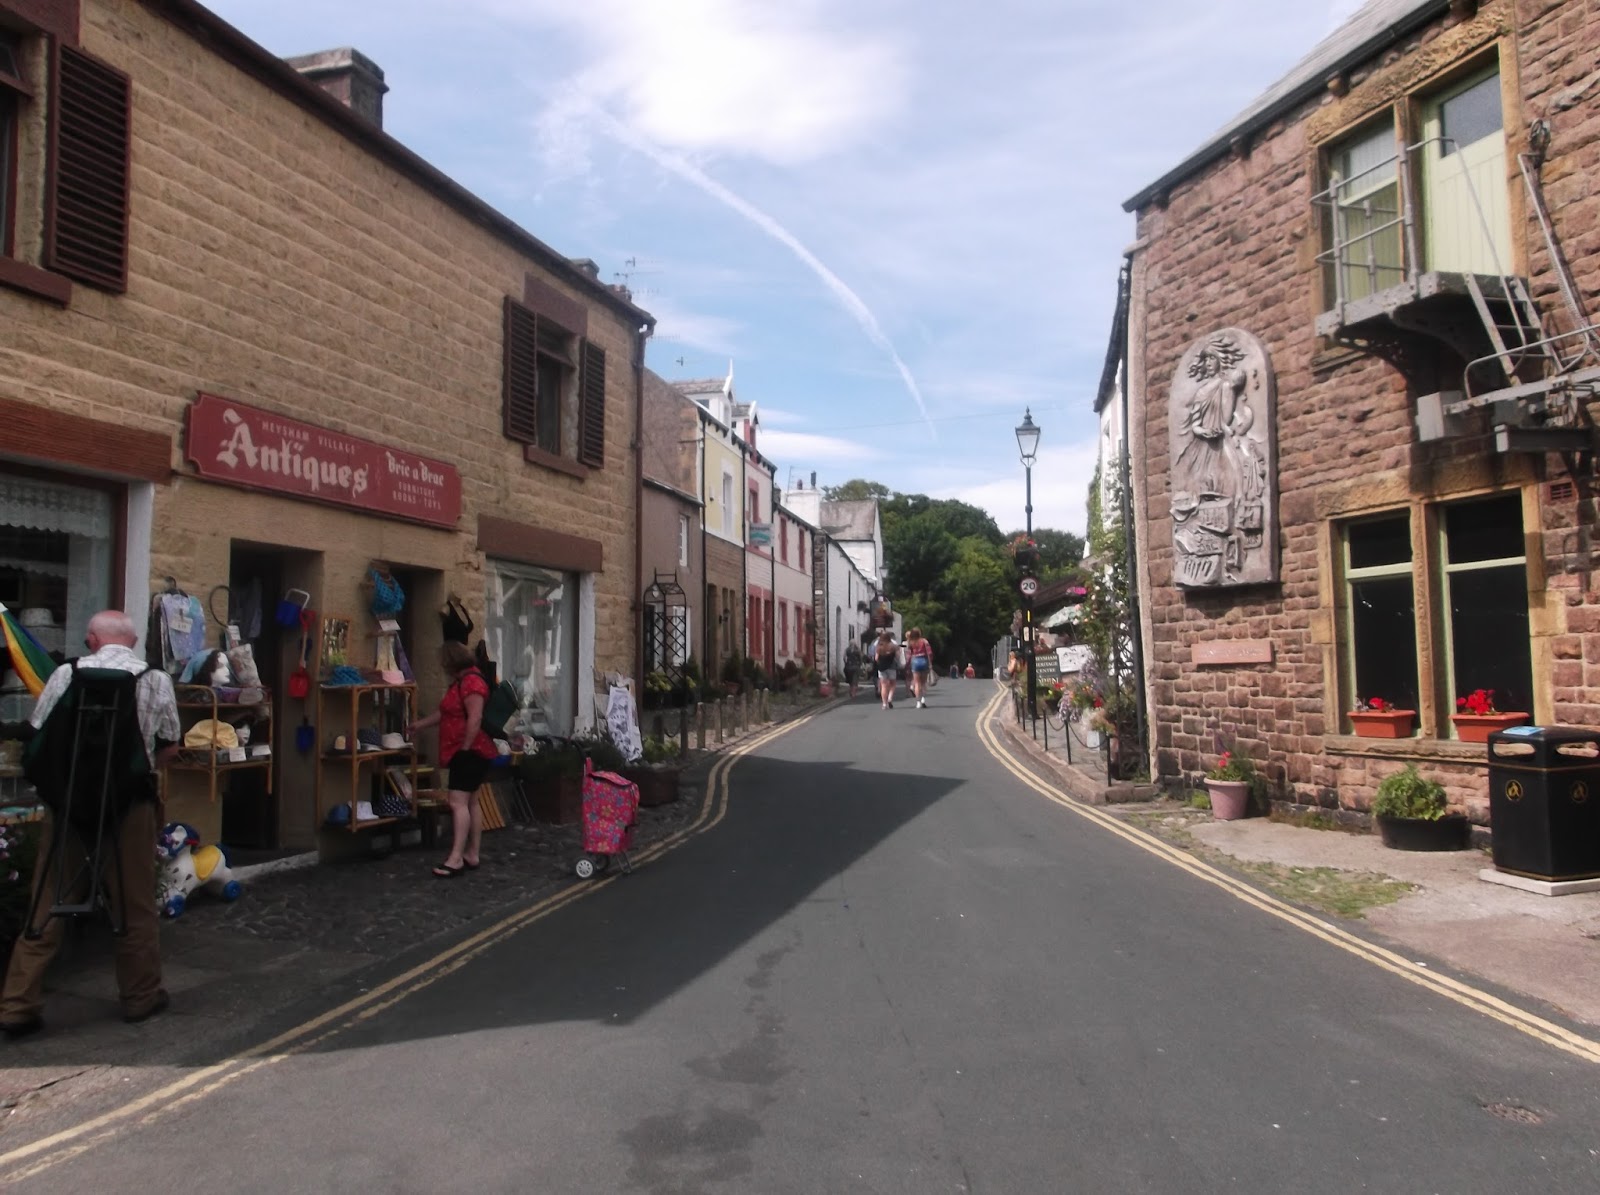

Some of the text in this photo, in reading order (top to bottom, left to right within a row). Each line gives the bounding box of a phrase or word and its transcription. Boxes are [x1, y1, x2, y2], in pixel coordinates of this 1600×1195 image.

[216, 408, 368, 498] Antiques
[262, 421, 355, 454] HEYSHAM VILLAGE
[386, 451, 444, 487] Bric a Brac
[1023, 582, 1036, 590] 20
